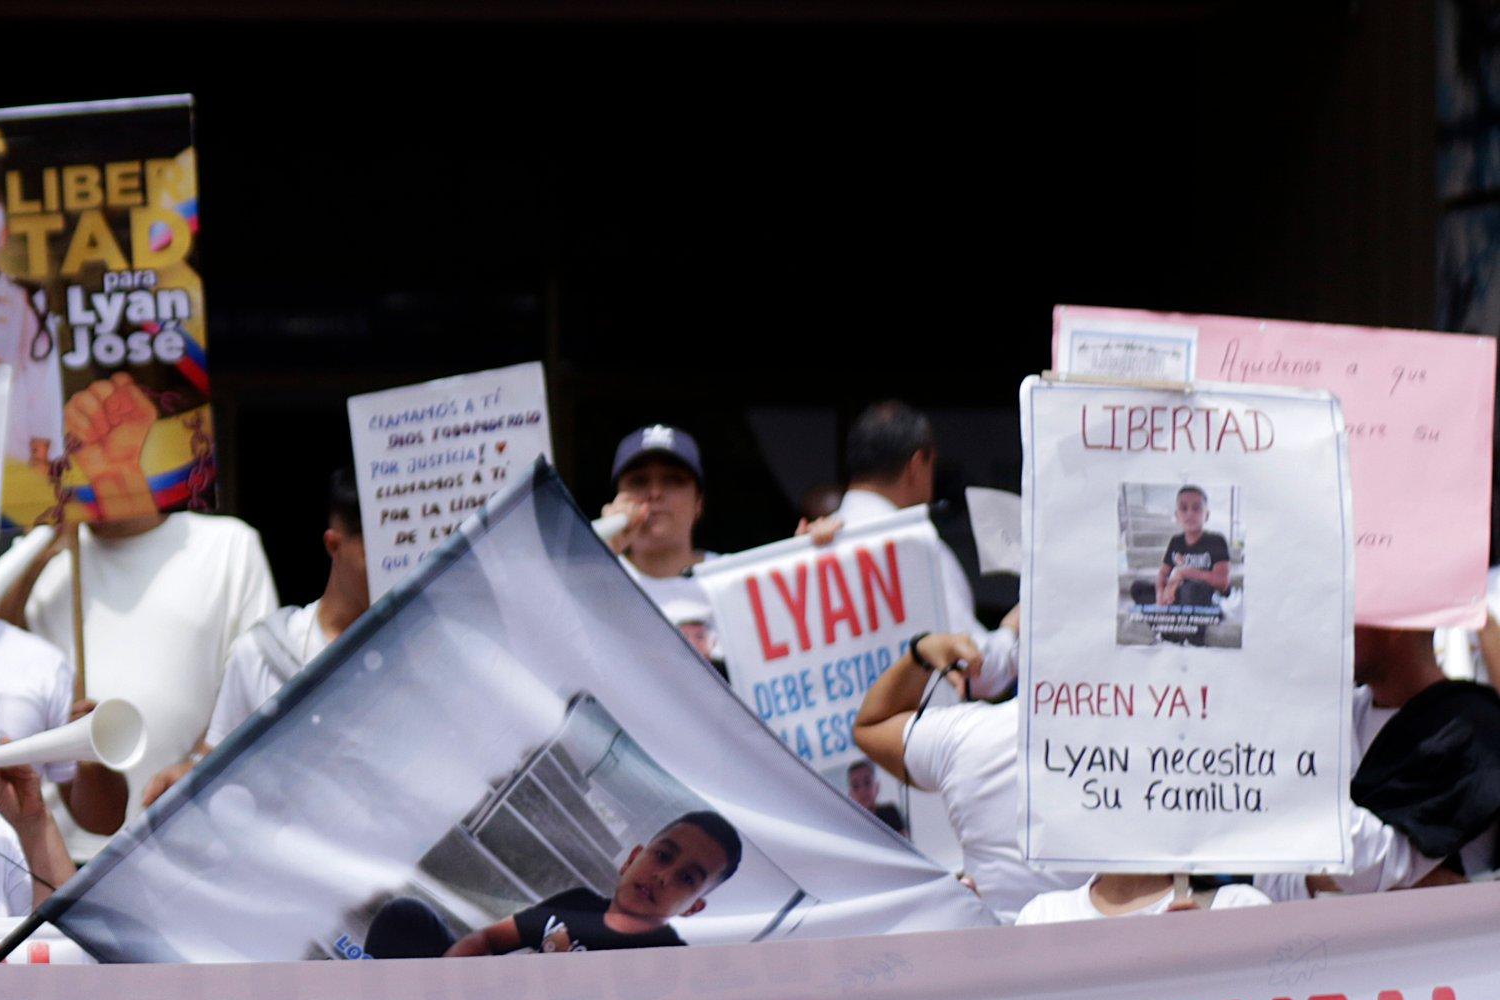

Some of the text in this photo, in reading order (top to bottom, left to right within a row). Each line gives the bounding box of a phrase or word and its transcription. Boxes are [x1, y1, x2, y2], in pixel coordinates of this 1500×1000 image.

[103, 270, 157, 294] para
[66, 285, 190, 335] Lyan
[63, 320, 186, 369] José
[1346, 362, 1358, 376] a
[1082, 405, 1274, 454] LIBERTAD
[422, 502, 441, 517] LA
[745, 539, 906, 662] LYAN
[753, 668, 817, 721] DEBE
[1034, 681, 1135, 717] PAREN
[1044, 739, 1317, 778] LYAN necesita a
